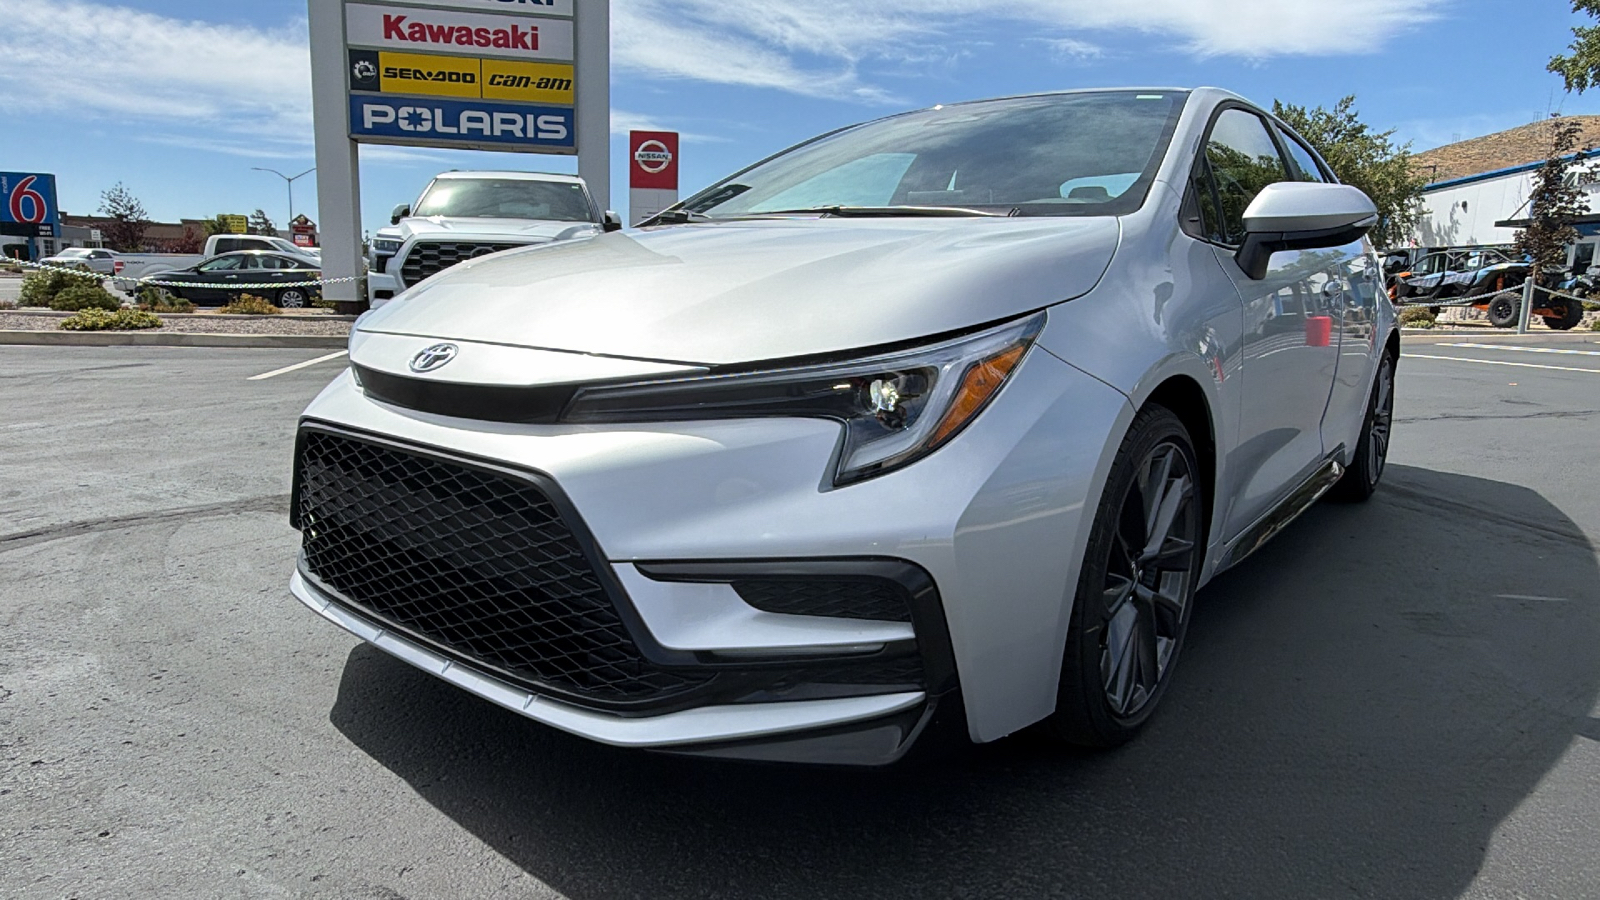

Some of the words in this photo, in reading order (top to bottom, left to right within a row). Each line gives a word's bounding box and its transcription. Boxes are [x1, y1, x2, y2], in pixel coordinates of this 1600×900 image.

[383, 14, 539, 50] Kawasaki
[488, 74, 572, 91] can-am
[363, 104, 568, 140] POLARIS
[637, 152, 669, 160] NISSAN
[9, 175, 47, 224] 6
